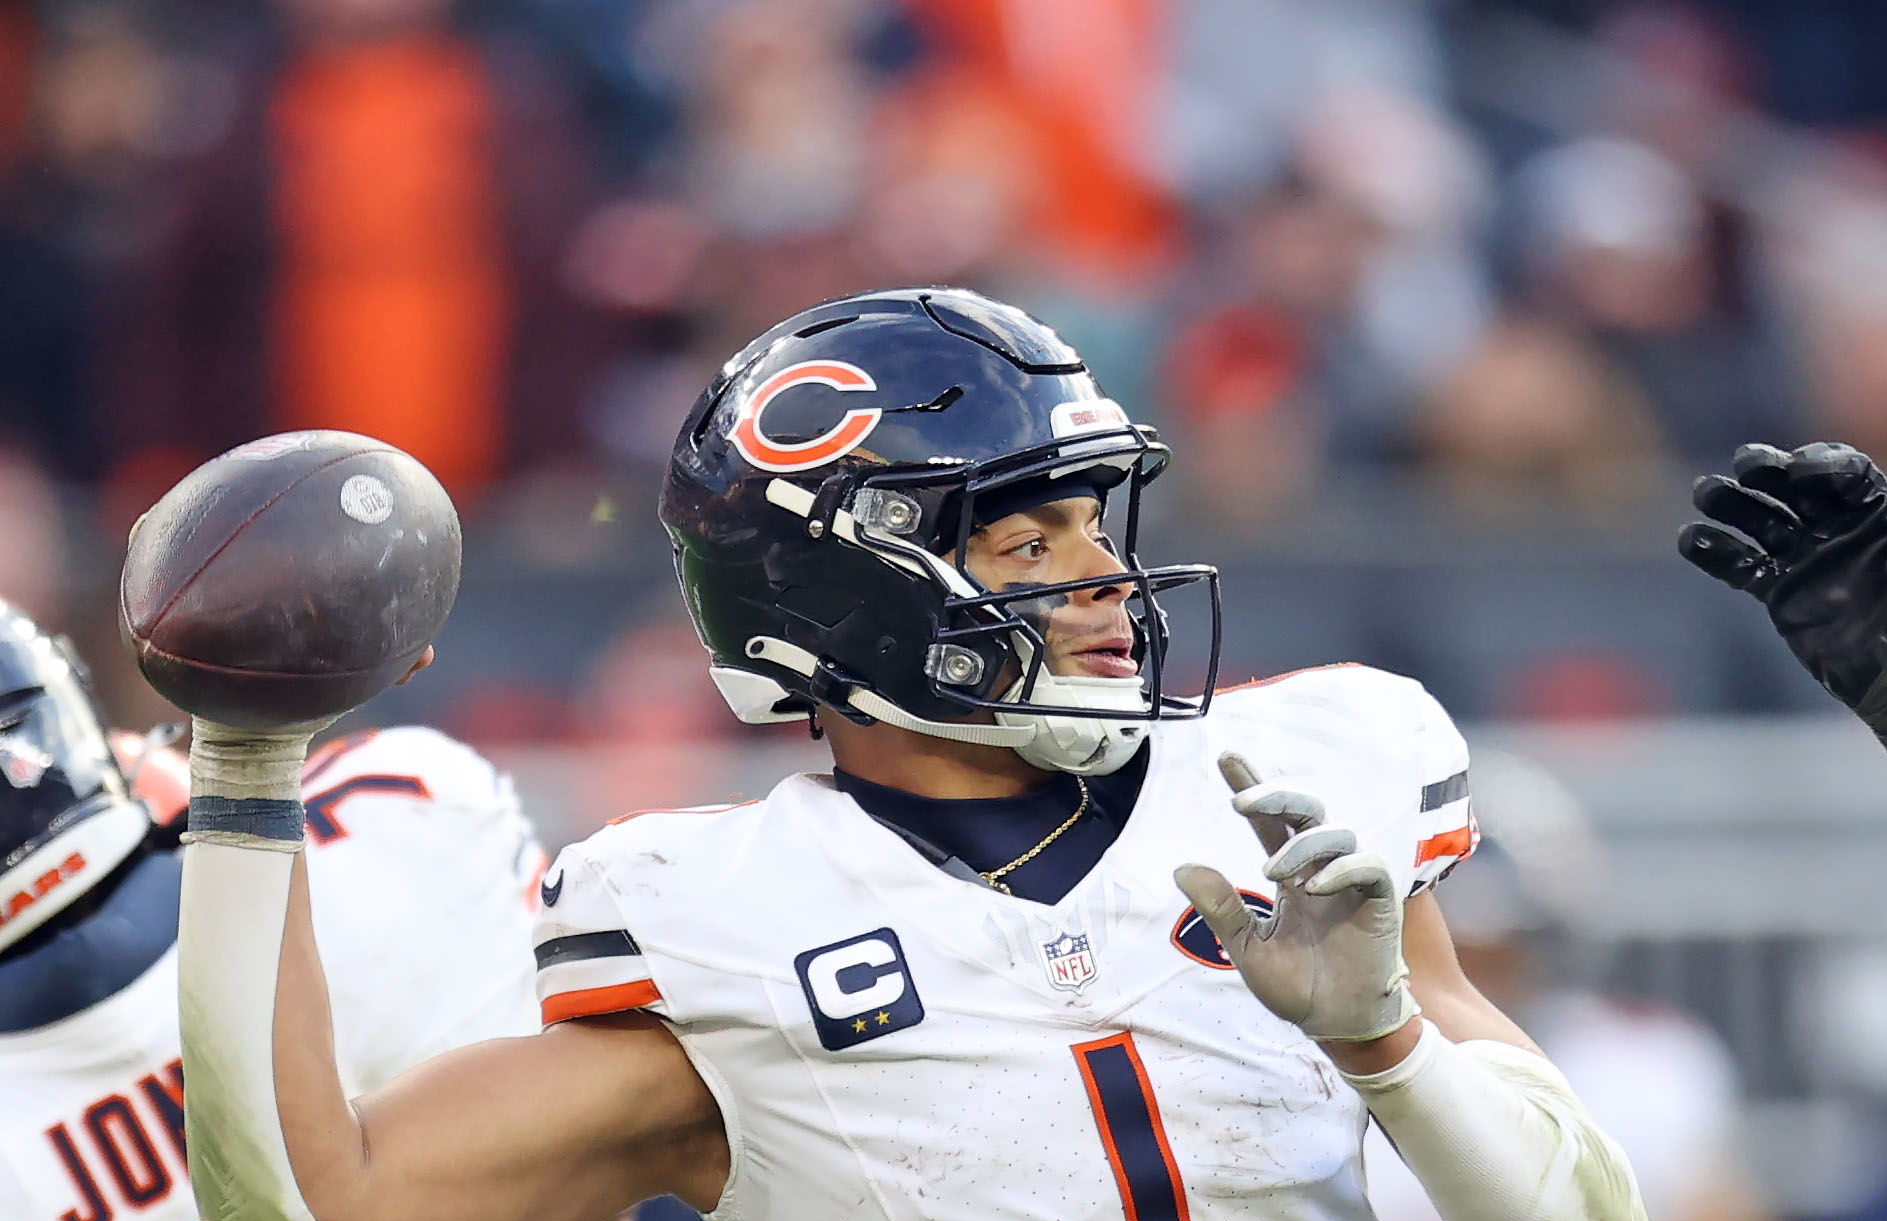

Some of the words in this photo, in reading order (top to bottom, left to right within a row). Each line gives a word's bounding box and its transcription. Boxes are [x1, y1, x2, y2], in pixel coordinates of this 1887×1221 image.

[726, 360, 882, 472] C
[0, 850, 87, 929] ARS
[806, 938, 906, 1020] C
[1053, 954, 1092, 982] NFL
